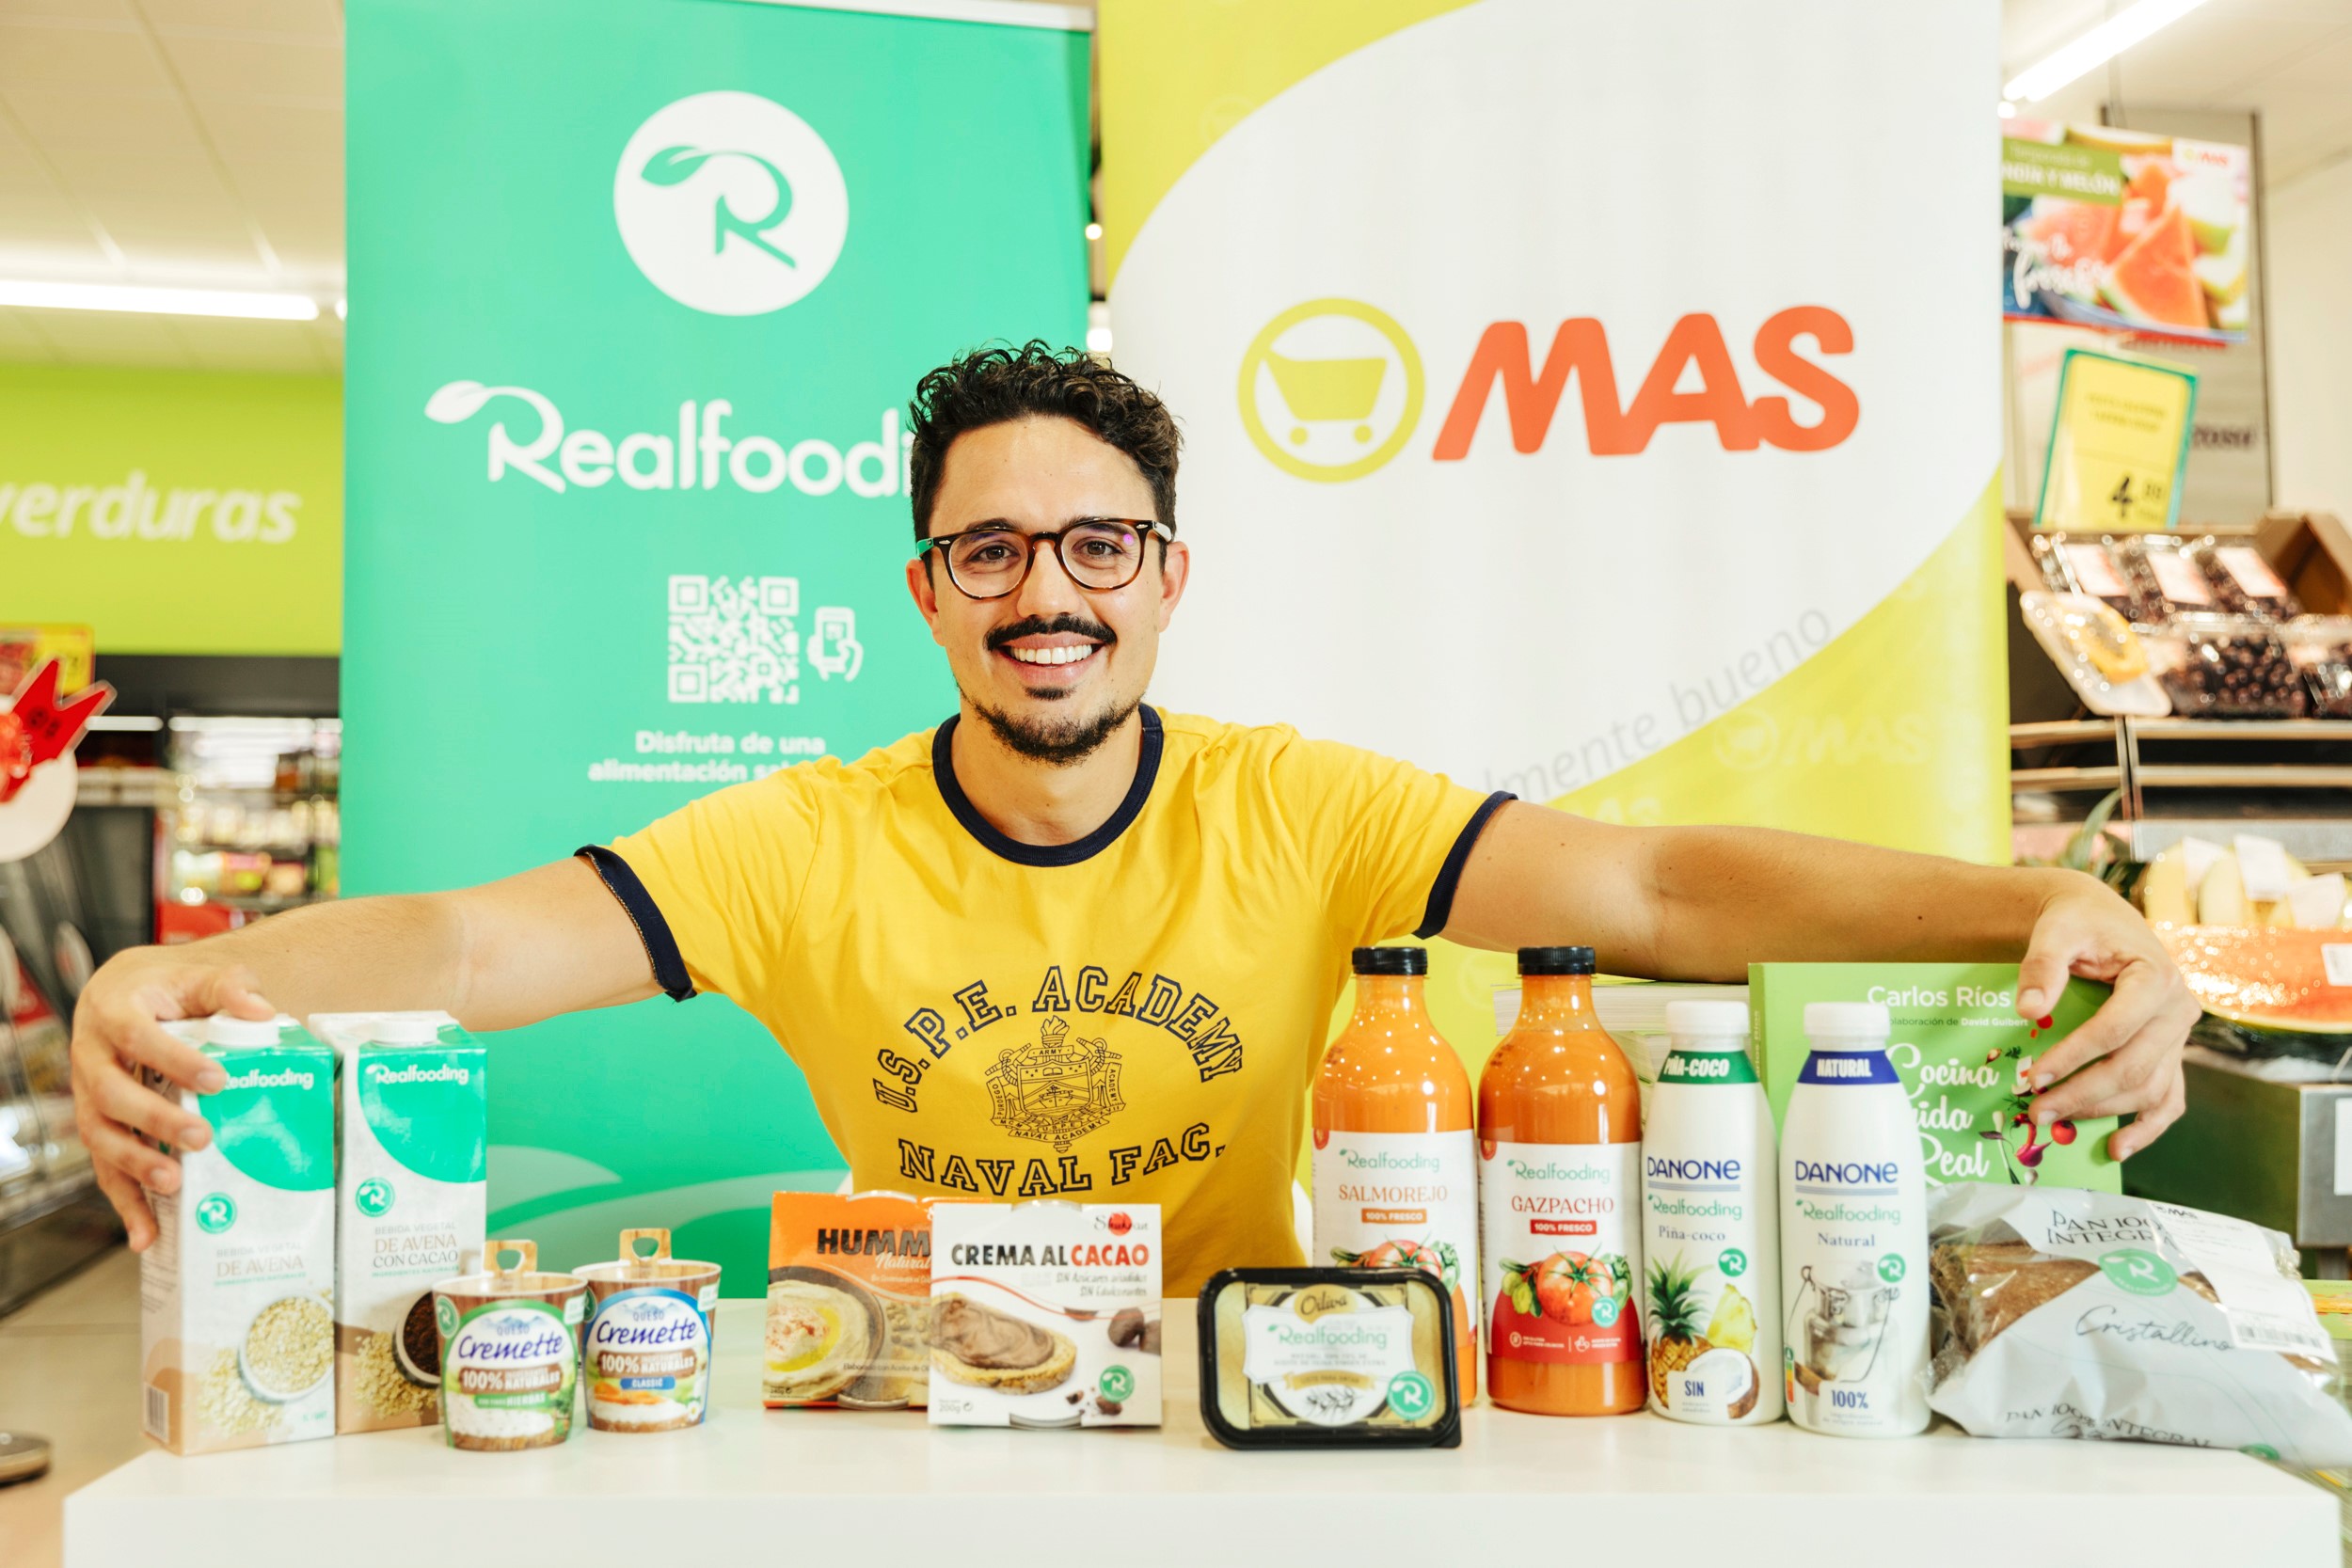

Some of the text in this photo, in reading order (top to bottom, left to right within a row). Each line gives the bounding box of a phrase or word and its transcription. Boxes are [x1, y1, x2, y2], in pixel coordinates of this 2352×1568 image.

[1432, 305, 1861, 461] MAS
[425, 380, 913, 498] Realfoodi
[2112, 476, 2133, 518] 4
[1485, 608, 1833, 801] lmente bueno
[635, 730, 826, 754] Disfruta de una
[588, 758, 747, 782] alimentación
[1867, 986, 2010, 1007] Carlos Ríos
[1890, 1017, 1945, 1026] olaboración
[1947, 1017, 1959, 1026] de
[1961, 1018, 1989, 1026] David
[873, 965, 1243, 1113] U.S.P.E. ACADEMY
[365, 1063, 469, 1085] Realfooding
[1816, 1057, 1873, 1079] NATURAL
[1107, 1069, 1119, 1103] ACADEMY
[1014, 1119, 1103, 1141] NAVAL ACADEMY
[898, 1122, 1226, 1197] NAVAL FAC.
[1340, 1148, 1440, 1172] Realfooding
[1507, 1159, 1610, 1184] Realfooding
[1339, 1184, 1448, 1203] SALMOREJO
[1511, 1196, 1614, 1214] GAZPACHO
[1648, 1194, 1742, 1220] Realfooding
[1795, 1199, 1900, 1224] Realfooding
[1366, 1212, 1423, 1221] 100% FRESCO
[2052, 1210, 2108, 1231] PAN
[374, 1222, 456, 1236] BEBIDA VEGETAL
[1534, 1223, 1593, 1232] 100% FRESCO
[1658, 1226, 1725, 1243] Piña-coco
[375, 1234, 457, 1254] DE AVENA
[817, 1228, 931, 1257] HUMM
[1817, 1231, 1876, 1247] Natural
[216, 1242, 304, 1259] BEBIDA VEGETAL
[373, 1249, 458, 1269] CON CACAO
[875, 1251, 931, 1269] Natural
[951, 1243, 1149, 1267] CREMA AL CACAO
[215, 1255, 304, 1278] DE AVENA
[1056, 1273, 1070, 1283] SIN
[1080, 1287, 1093, 1297] SIN
[632, 1309, 665, 1322] QUESO
[596, 1318, 697, 1344] Cremette
[1267, 1324, 1388, 1349] Realfooding
[2075, 1305, 2234, 1352] Cristallino
[458, 1331, 563, 1360] Cremette
[601, 1354, 640, 1374] 100%
[641, 1355, 694, 1374] NATURALES
[463, 1370, 503, 1390] 100%
[505, 1370, 562, 1390] NATURALES
[632, 1378, 663, 1388] CLASSIC
[1684, 1380, 1705, 1397] SIN
[1832, 1390, 1868, 1409] 100%
